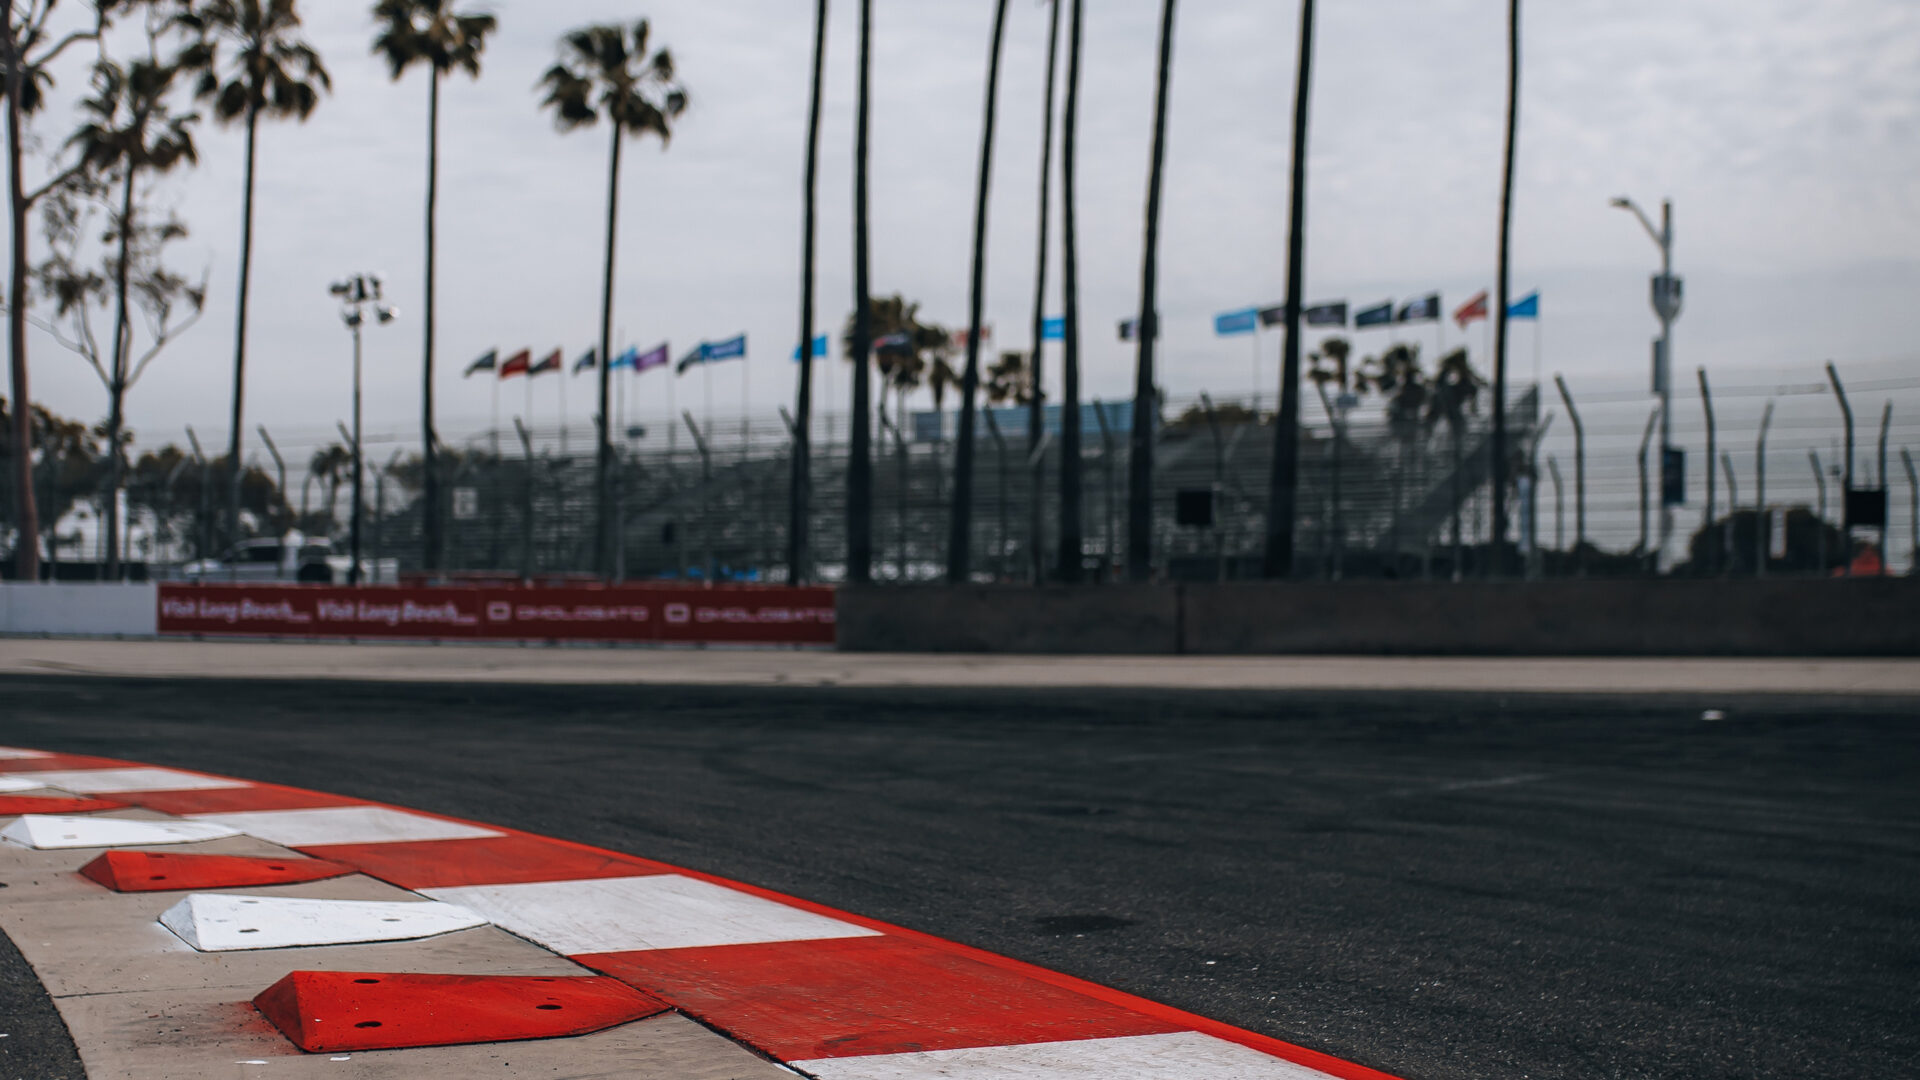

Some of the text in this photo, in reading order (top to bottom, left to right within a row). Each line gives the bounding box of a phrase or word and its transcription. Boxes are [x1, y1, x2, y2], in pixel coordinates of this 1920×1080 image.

[162, 598, 194, 617] Visit
[200, 599, 236, 623] Long
[241, 599, 294, 620] Beach
[317, 599, 353, 621] Visit
[359, 600, 398, 626] Long
[402, 600, 458, 623] Beach
